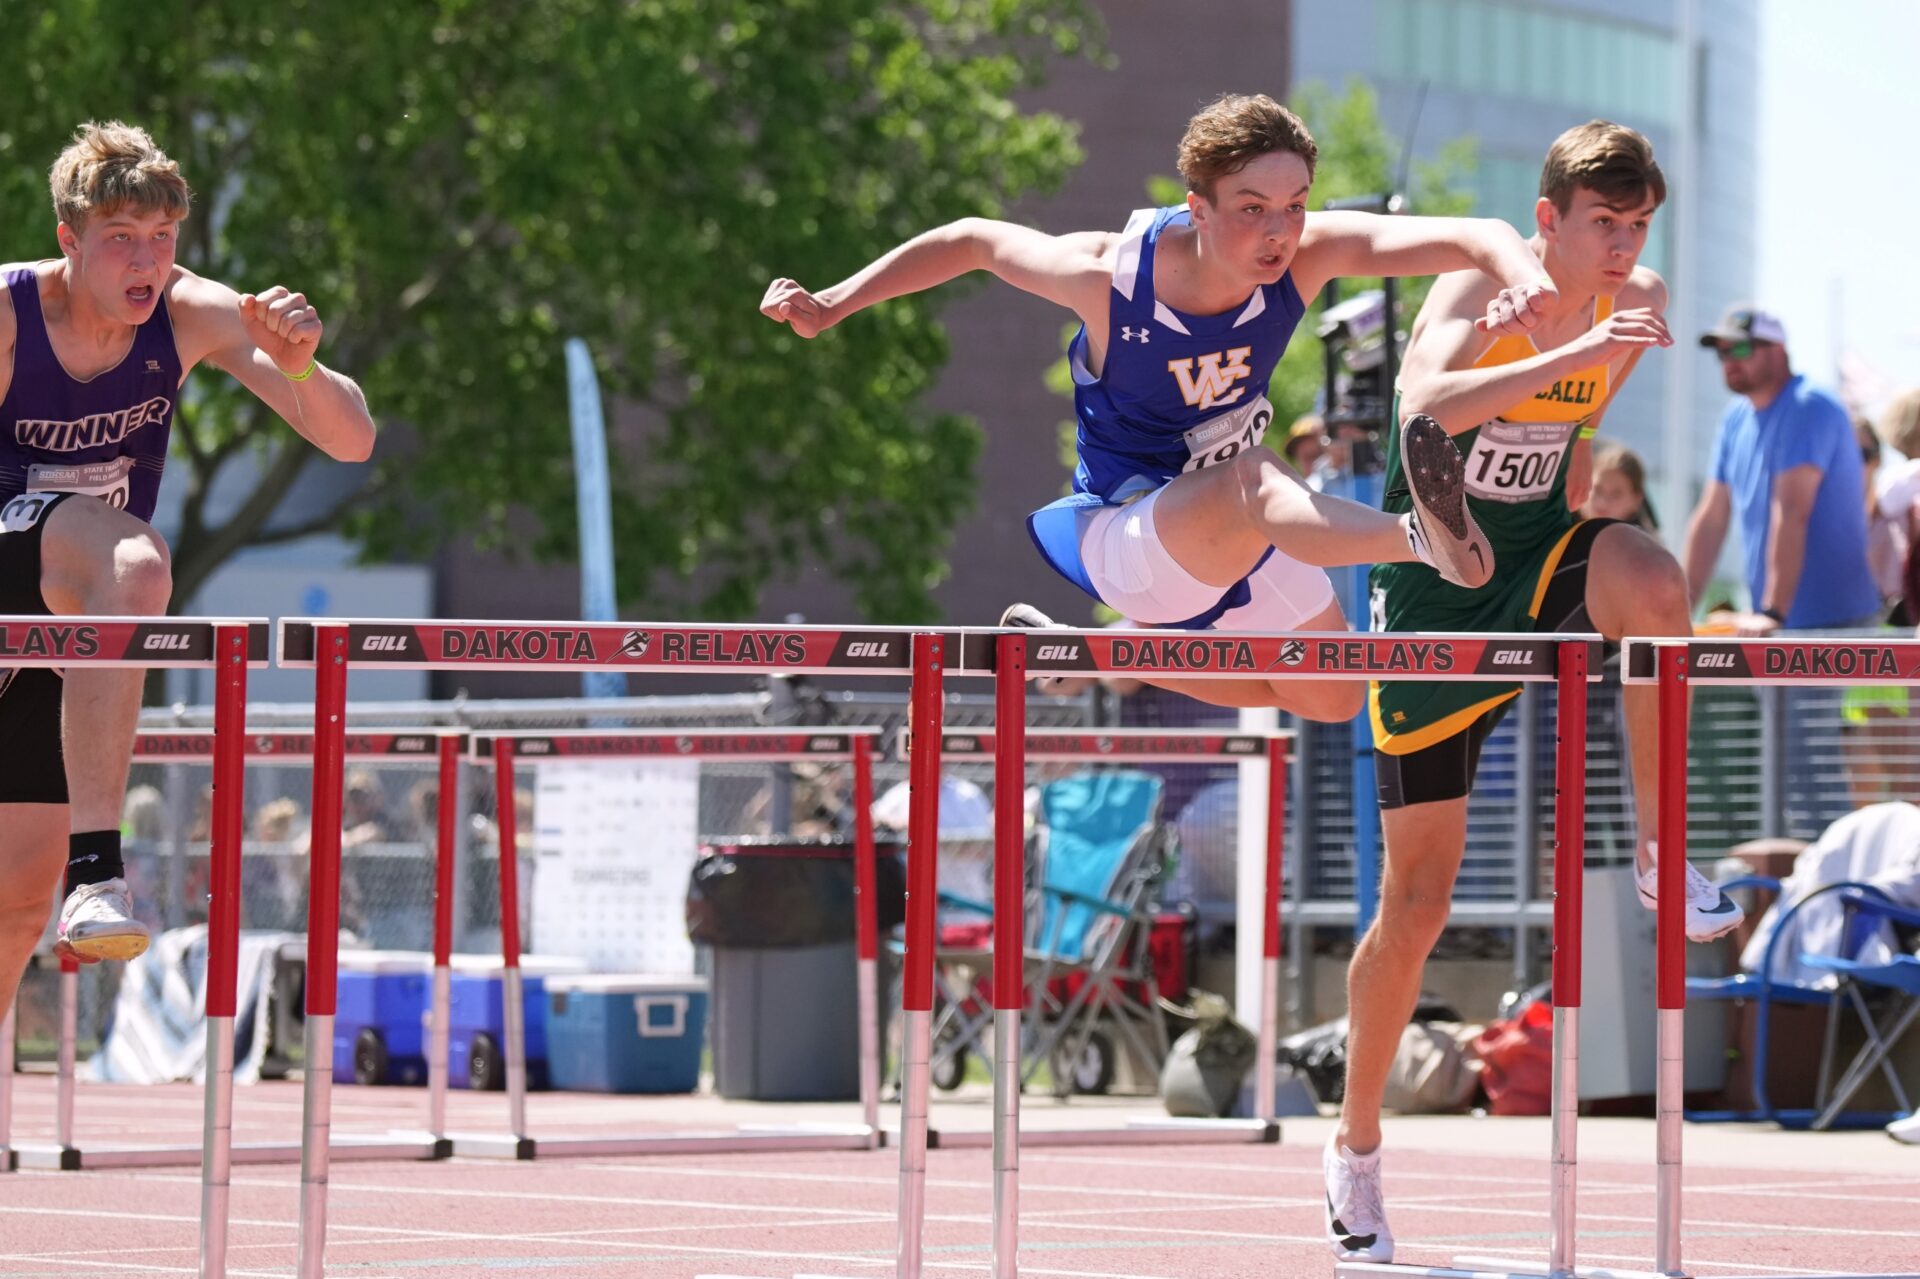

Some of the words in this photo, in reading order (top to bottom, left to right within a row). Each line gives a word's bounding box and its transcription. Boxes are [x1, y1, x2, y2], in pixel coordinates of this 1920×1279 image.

[1535, 381, 1595, 403] ALLI
[15, 396, 170, 451] WINNER
[84, 466, 104, 474] STATE
[1476, 449, 1560, 488] 1500
[144, 634, 190, 650] GILL
[362, 635, 407, 650] GILL
[441, 629, 597, 660] DAKOTA
[661, 632, 806, 664] RELAYS
[846, 642, 889, 657] GILL
[1036, 645, 1079, 660] GILL
[1111, 640, 1256, 669] DAKOTA
[1317, 641, 1454, 671] RELAYS
[1492, 650, 1534, 665] GILL
[1696, 653, 1736, 668] GILL
[1764, 647, 1900, 676] DAKOTA
